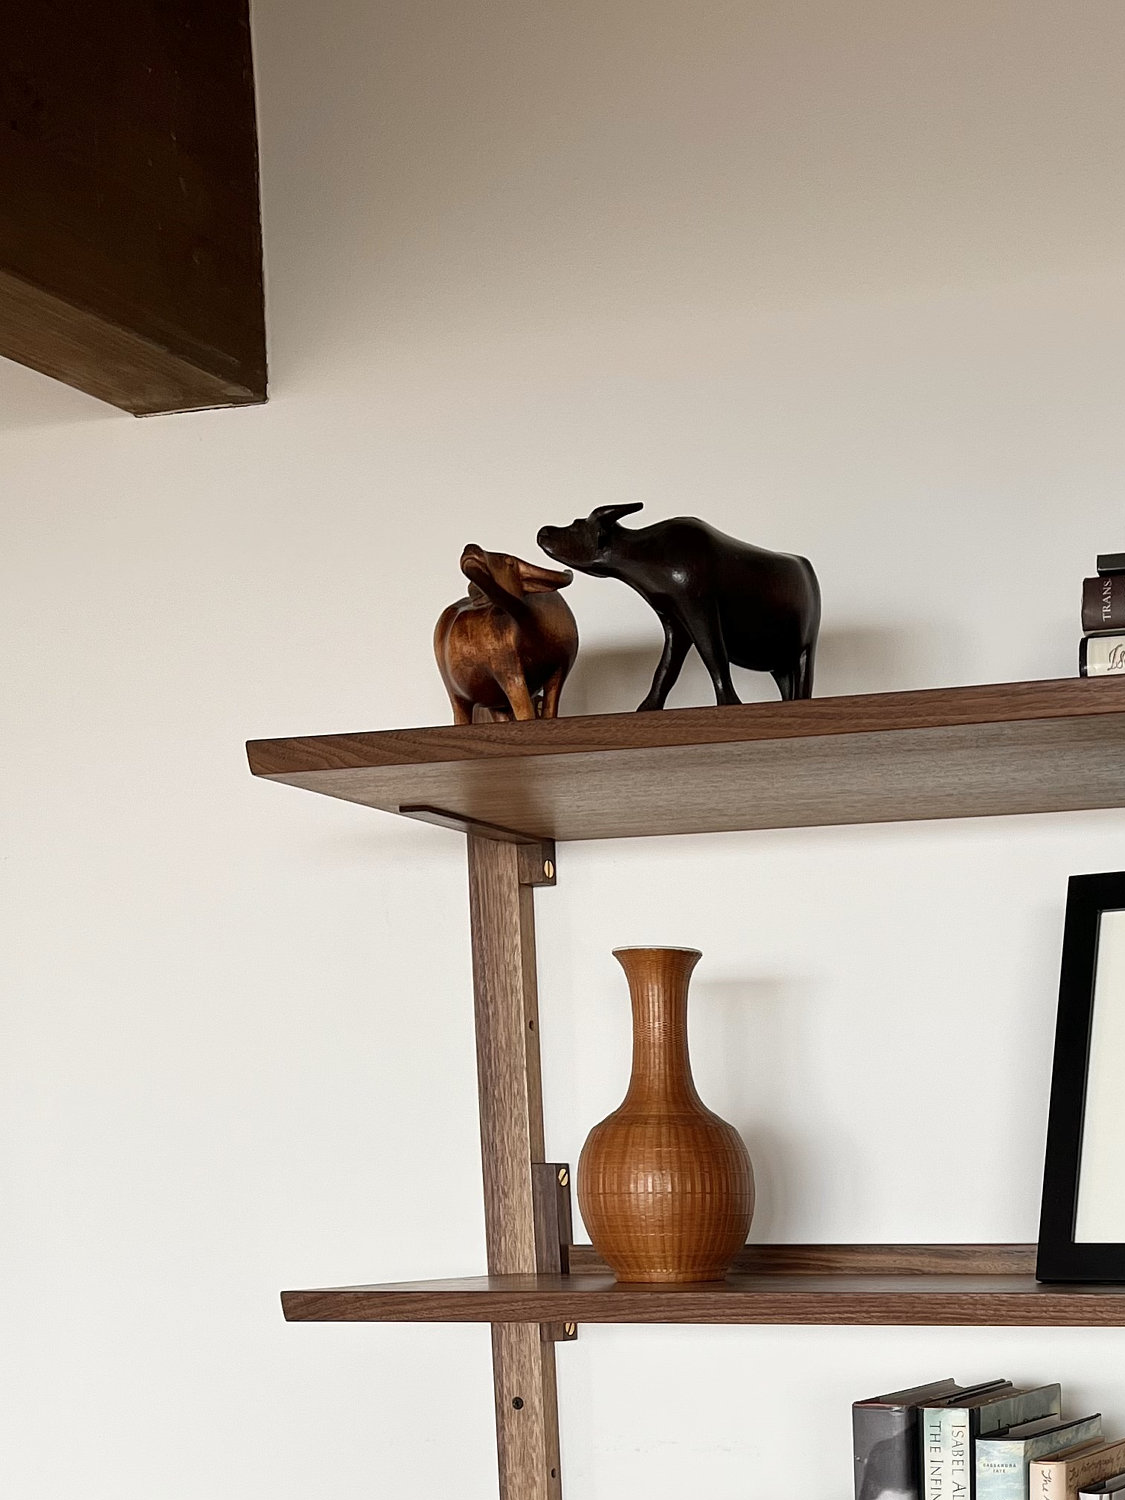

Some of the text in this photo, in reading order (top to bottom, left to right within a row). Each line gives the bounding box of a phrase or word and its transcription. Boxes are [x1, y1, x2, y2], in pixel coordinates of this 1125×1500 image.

[1102, 578, 1113, 622] TRANS
[929, 1420, 942, 1453] THE
[951, 1424, 966, 1476] ISABEL
[1042, 1470, 1052, 1493] The
